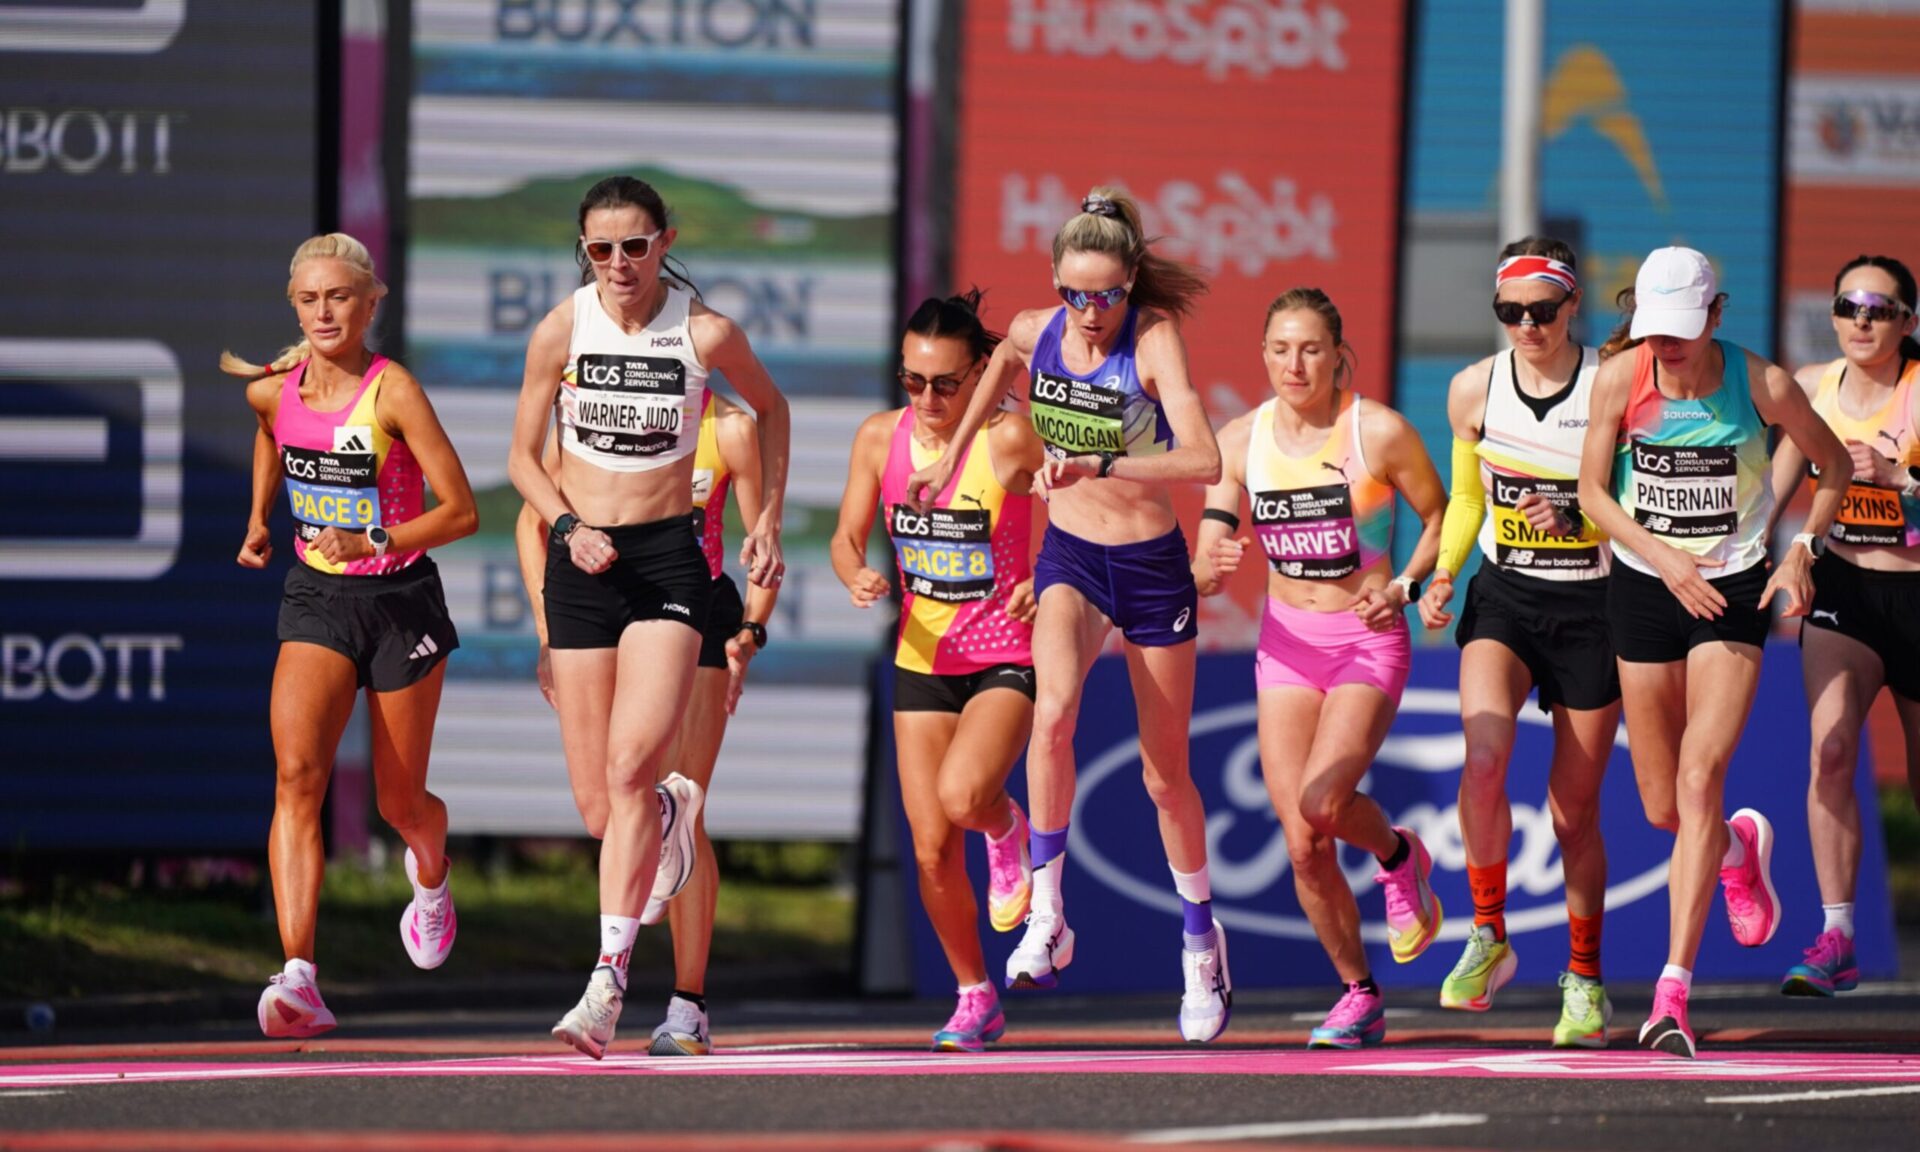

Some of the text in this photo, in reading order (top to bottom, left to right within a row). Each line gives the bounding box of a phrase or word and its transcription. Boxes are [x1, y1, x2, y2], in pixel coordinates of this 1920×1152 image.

[0, 108, 188, 176] BOTT
[1000, 172, 1335, 277] HSpot
[651, 337, 683, 347] HOKA
[625, 362, 648, 371] TATA
[584, 361, 620, 386] tcs
[624, 370, 679, 381] CONSULTANCY
[624, 379, 659, 388] SERVICES
[1035, 371, 1068, 402] tcs
[1071, 380, 1091, 391] TATA
[1070, 389, 1119, 405] CONSULTANCY
[1069, 397, 1099, 410] SERVICES
[579, 400, 679, 432] WARNER-JUDD
[1663, 410, 1713, 421] saucony
[1035, 413, 1120, 448] MCCOLGAN
[615, 443, 634, 452] new
[1636, 446, 1671, 473] tcs
[1674, 451, 1698, 459] TATA
[286, 452, 316, 479] tcs
[319, 457, 339, 466] TATA
[1674, 458, 1730, 466] CONSULTANCY
[319, 465, 370, 476] CONSULTANCY
[1674, 465, 1710, 473] SERVICES
[320, 474, 351, 483] SERVICES
[1535, 484, 1558, 492] TATA
[1291, 493, 1314, 502] TATA
[1637, 482, 1733, 512] PATERNAIN
[292, 489, 373, 524] PACE 9
[1256, 497, 1290, 520] tcs
[1292, 498, 1344, 510] CONSULTANCY
[1840, 496, 1900, 521] PKINS
[932, 513, 954, 522] TATA
[1294, 508, 1327, 518] SERVICES
[896, 510, 929, 536] tcs
[932, 521, 983, 531] CONSULTANCY
[932, 530, 965, 538] SERVICES
[1672, 525, 1690, 534] new
[1691, 523, 1729, 535] balance
[1261, 526, 1352, 556] HARVEY
[1845, 534, 1861, 542] new
[1862, 534, 1898, 543] balance
[902, 546, 987, 577] PACE 8
[1535, 559, 1552, 567] new
[1553, 557, 1590, 567] balance
[1304, 569, 1320, 577] new
[1320, 565, 1354, 578] balance
[933, 591, 948, 600] new
[949, 590, 986, 600] balance
[662, 602, 691, 616] HOKA
